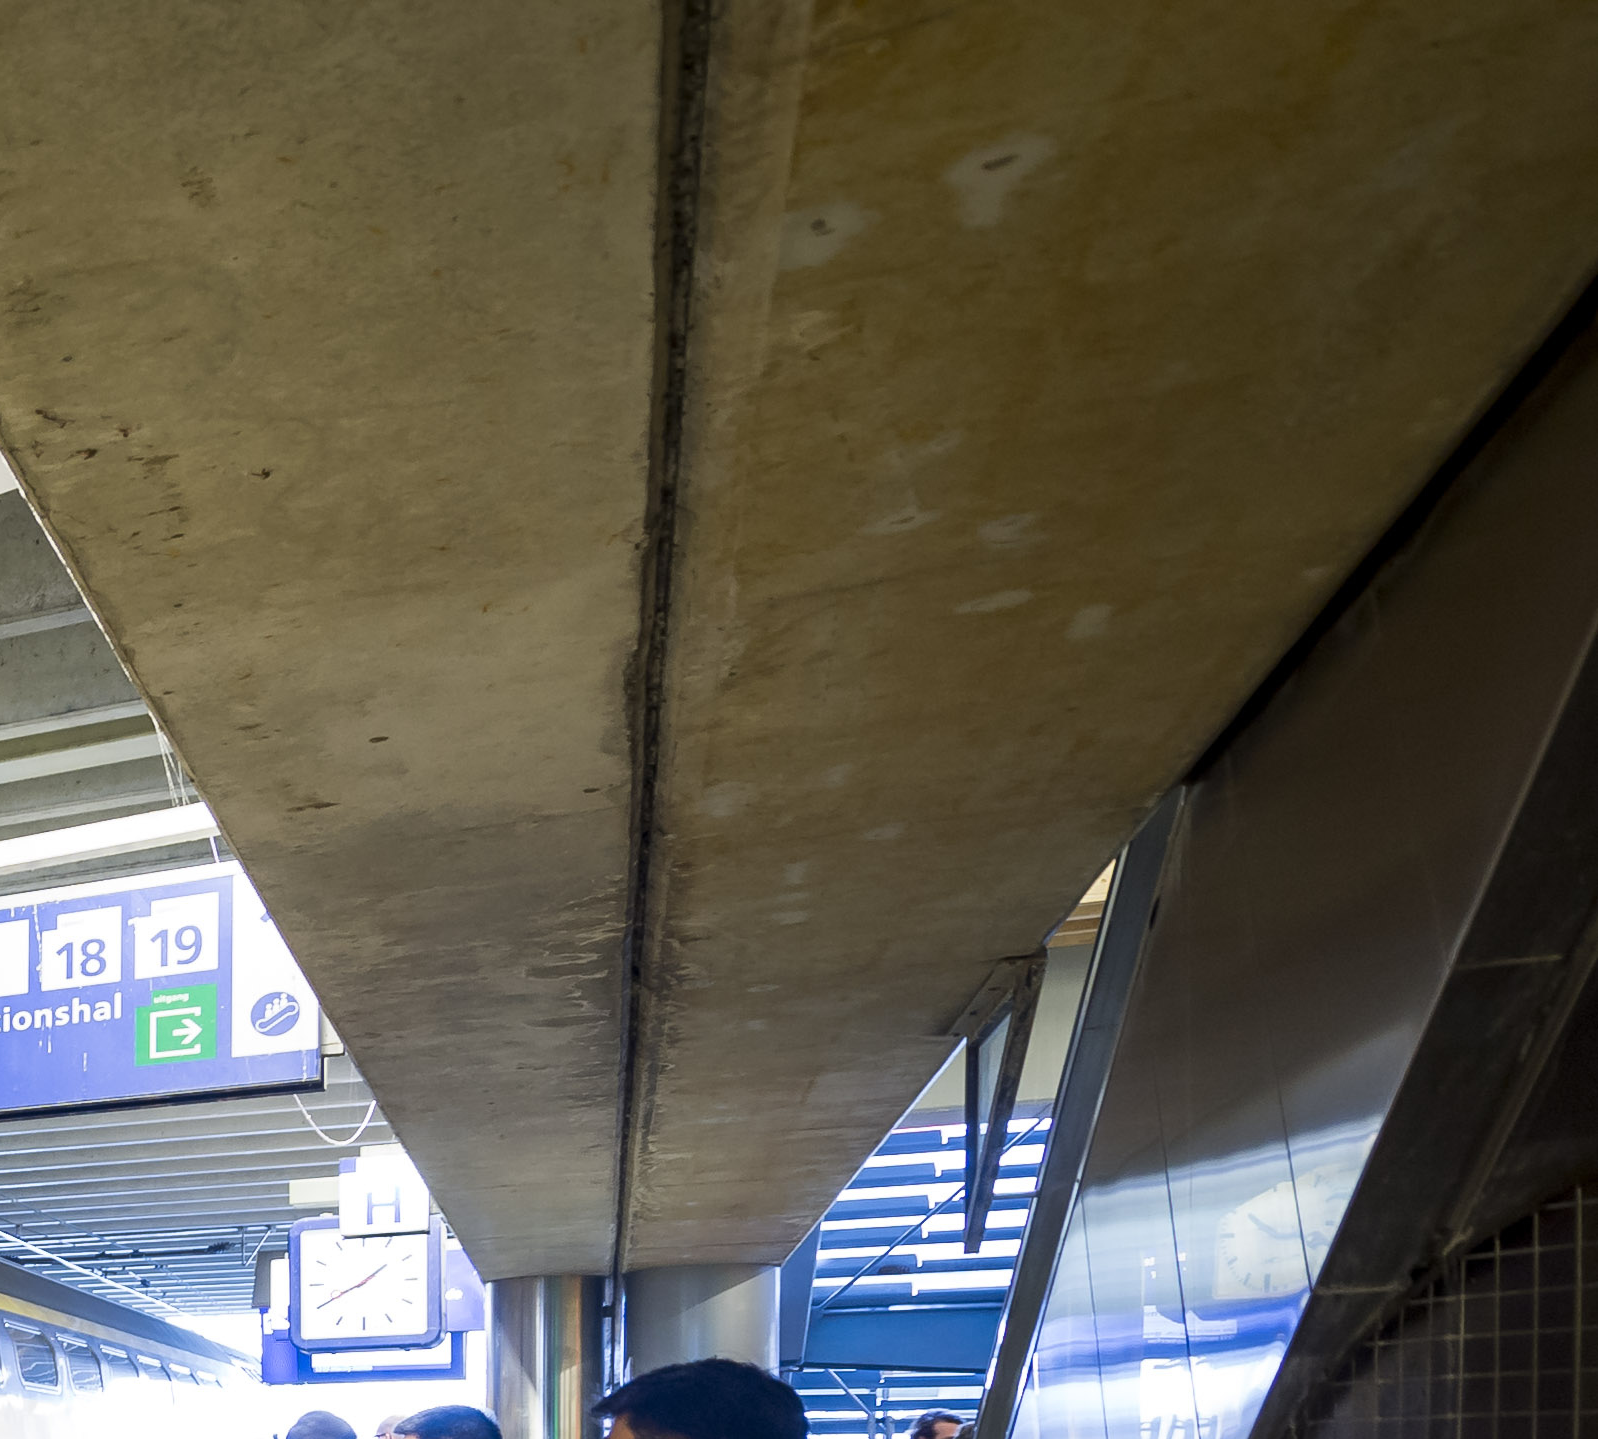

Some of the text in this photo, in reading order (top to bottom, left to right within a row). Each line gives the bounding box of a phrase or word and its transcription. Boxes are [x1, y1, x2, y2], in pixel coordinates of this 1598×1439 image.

[56, 938, 107, 979] 18
[150, 925, 203, 967] 19
[367, 1186, 401, 1225] H
